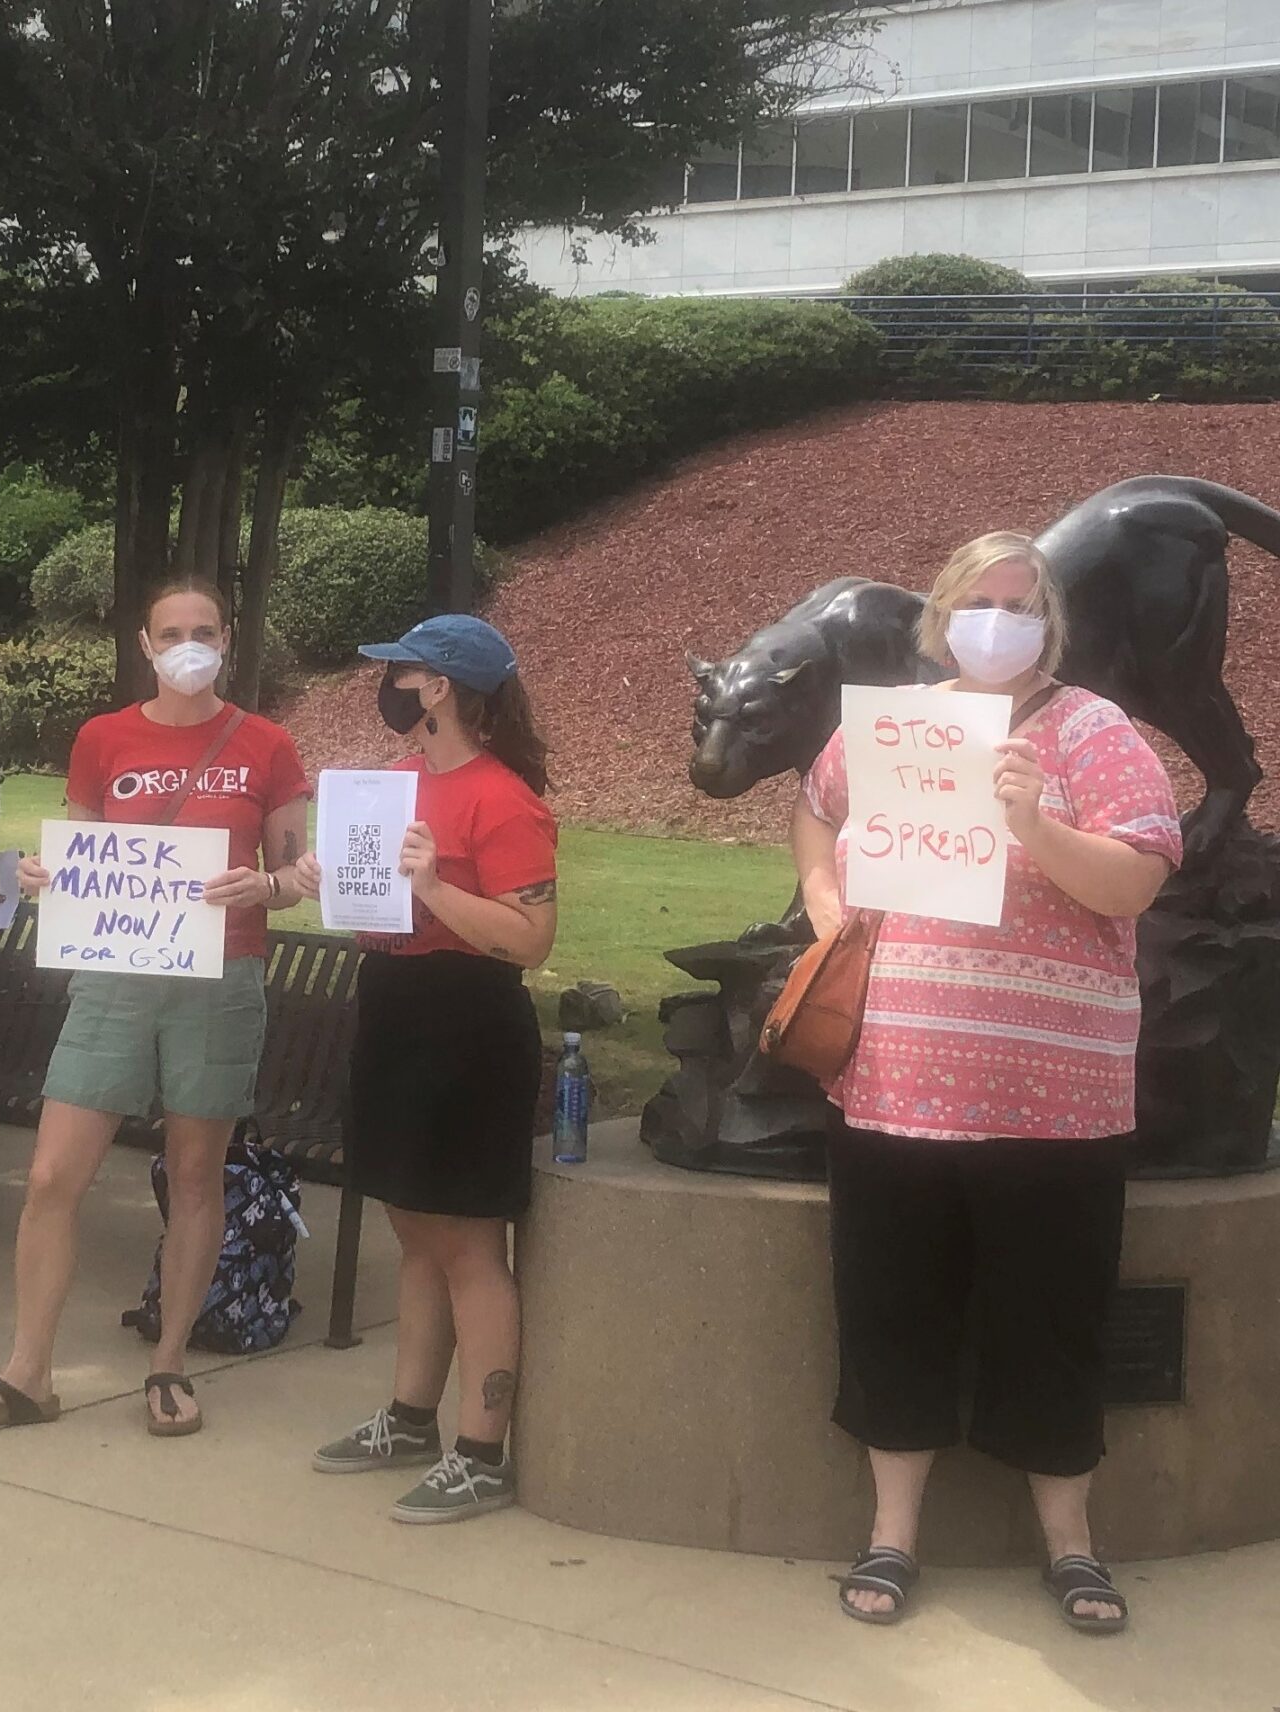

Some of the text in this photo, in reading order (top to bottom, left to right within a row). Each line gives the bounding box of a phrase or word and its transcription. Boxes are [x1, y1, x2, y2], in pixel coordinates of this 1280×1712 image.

[874, 715, 965, 751] STOP
[890, 765, 956, 793] THE
[66, 831, 182, 870] MASK
[859, 813, 996, 868] SPREAD
[50, 866, 205, 904] MANDATE
[337, 866, 392, 880] STOP THE
[338, 882, 391, 896] SPREAD!
[60, 944, 195, 972] FOR GSU
